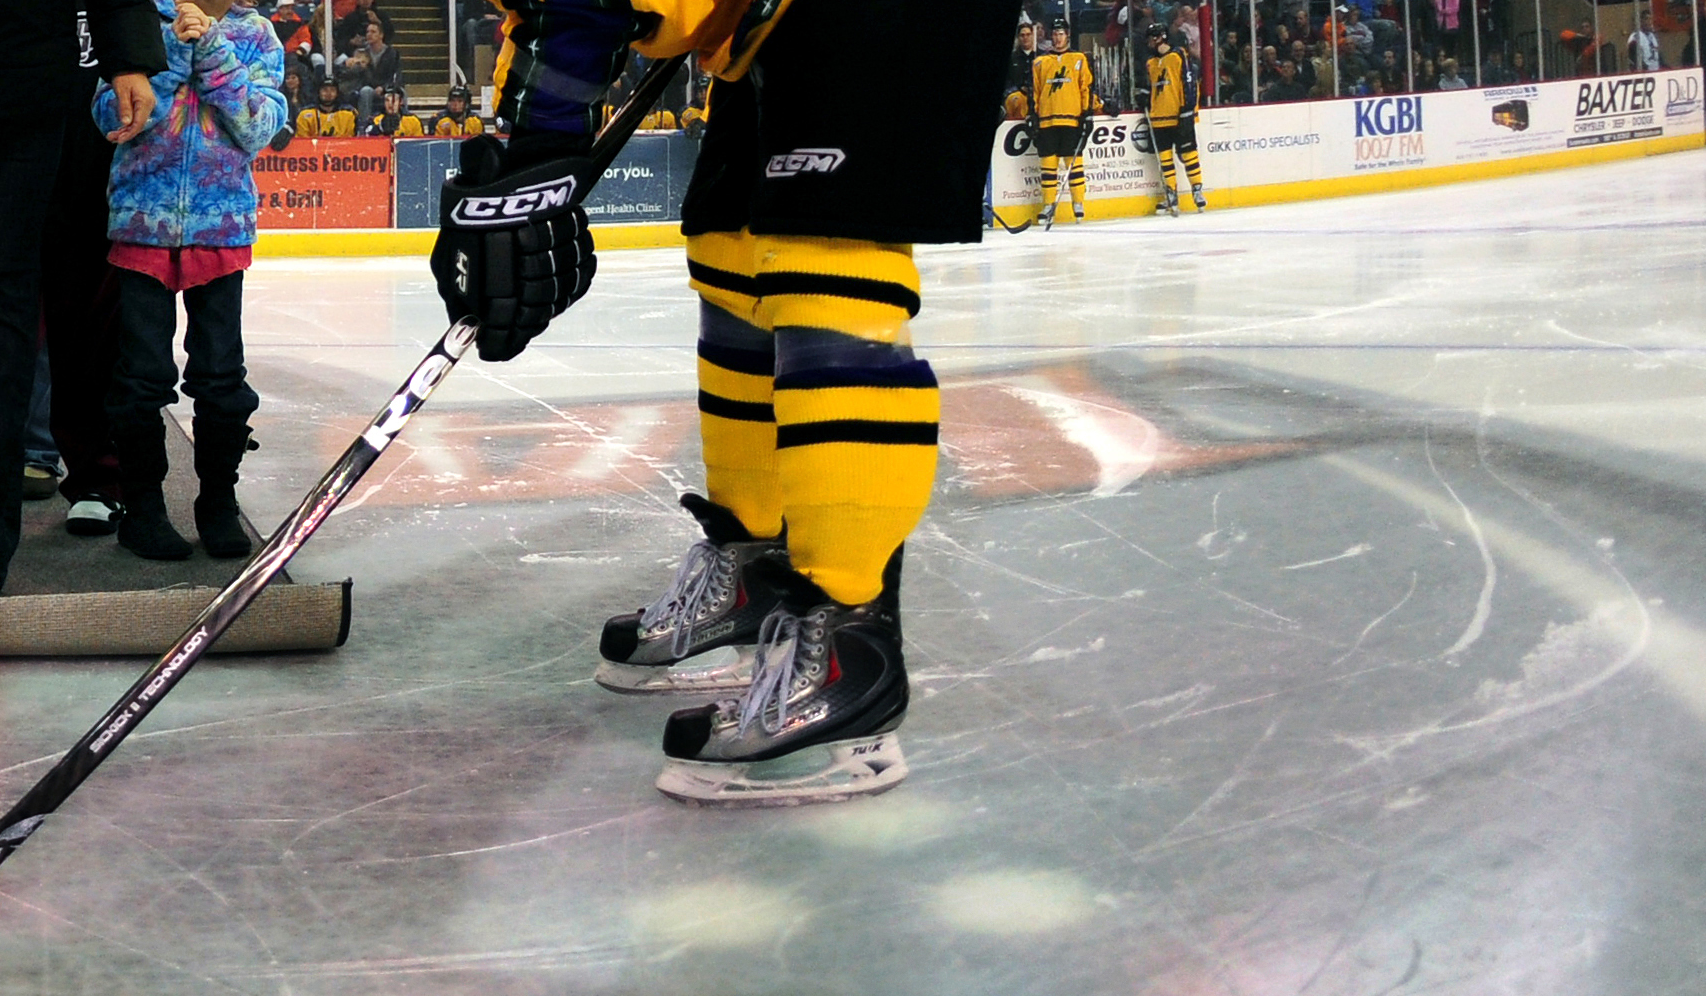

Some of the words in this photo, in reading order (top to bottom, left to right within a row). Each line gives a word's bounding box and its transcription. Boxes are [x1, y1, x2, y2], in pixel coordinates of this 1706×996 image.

[1576, 77, 1656, 117] BAXTER
[1667, 76, 1698, 103] D&D
[1354, 97, 1423, 138] KGBI
[1573, 120, 1606, 134] CHRYSLER
[1632, 115, 1654, 127] DODGE
[1088, 146, 1126, 160] VOLVO
[1208, 135, 1232, 153] GIKK
[1233, 136, 1268, 151] ORTHO
[1269, 133, 1320, 150] SPECIALISTS
[1399, 134, 1424, 157] FM
[251, 154, 318, 172] attress
[322, 154, 388, 173] Factory
[622, 163, 654, 181] you.
[771, 152, 835, 175] CCM
[269, 192, 282, 208] &
[286, 190, 323, 208] Grill
[1002, 190, 1032, 200] Proudly
[1089, 184, 1104, 193] Plus
[1105, 183, 1123, 192] Years
[1124, 182, 1133, 191] Of
[464, 186, 567, 217] CCM
[607, 203, 635, 214] Health
[636, 202, 663, 213] Clinic
[139, 625, 210, 703] TECHNOLOGY
